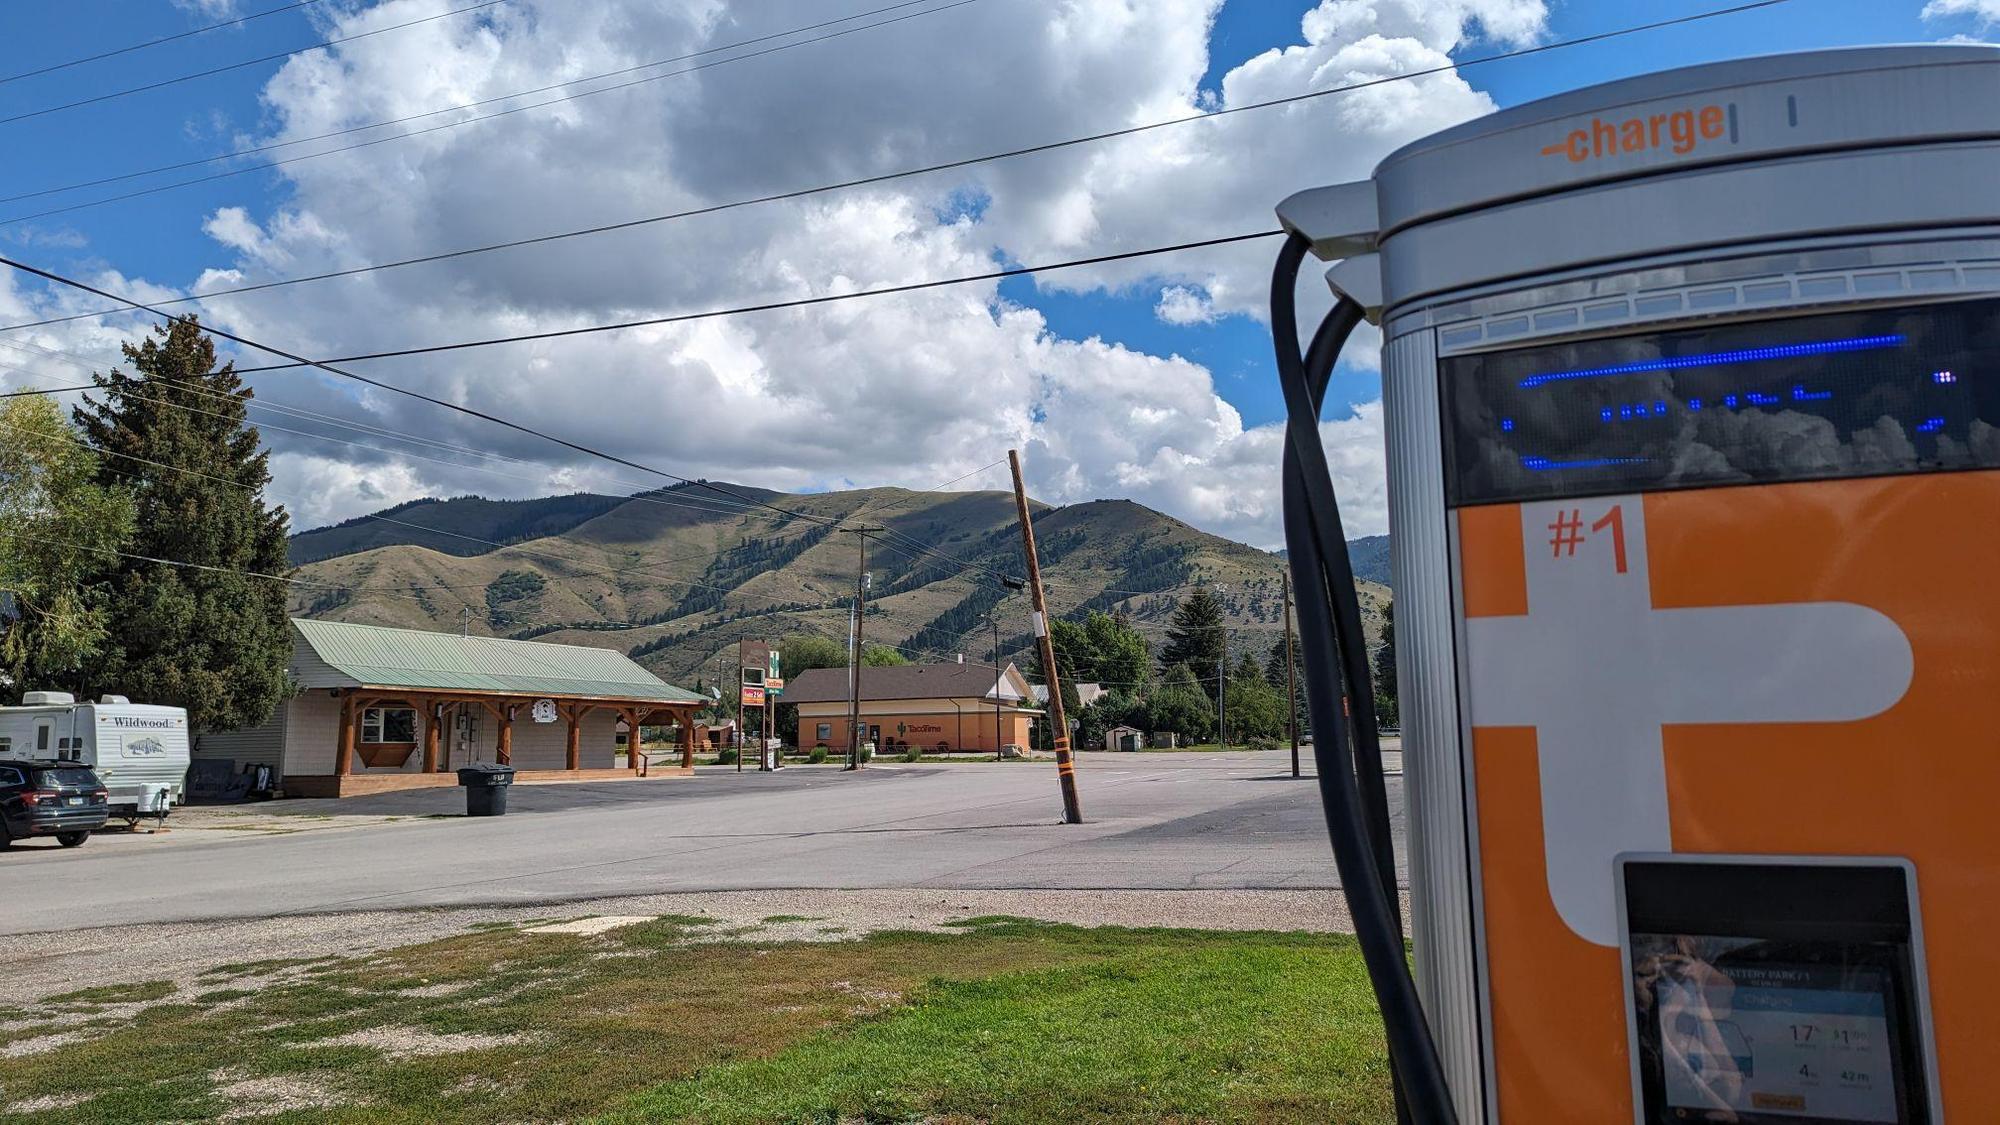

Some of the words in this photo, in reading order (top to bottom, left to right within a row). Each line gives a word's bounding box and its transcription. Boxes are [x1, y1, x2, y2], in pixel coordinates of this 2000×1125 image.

[1548, 505, 1627, 573] #1
[115, 717, 169, 728] Wildwood
[907, 724, 942, 732] TacoTime
